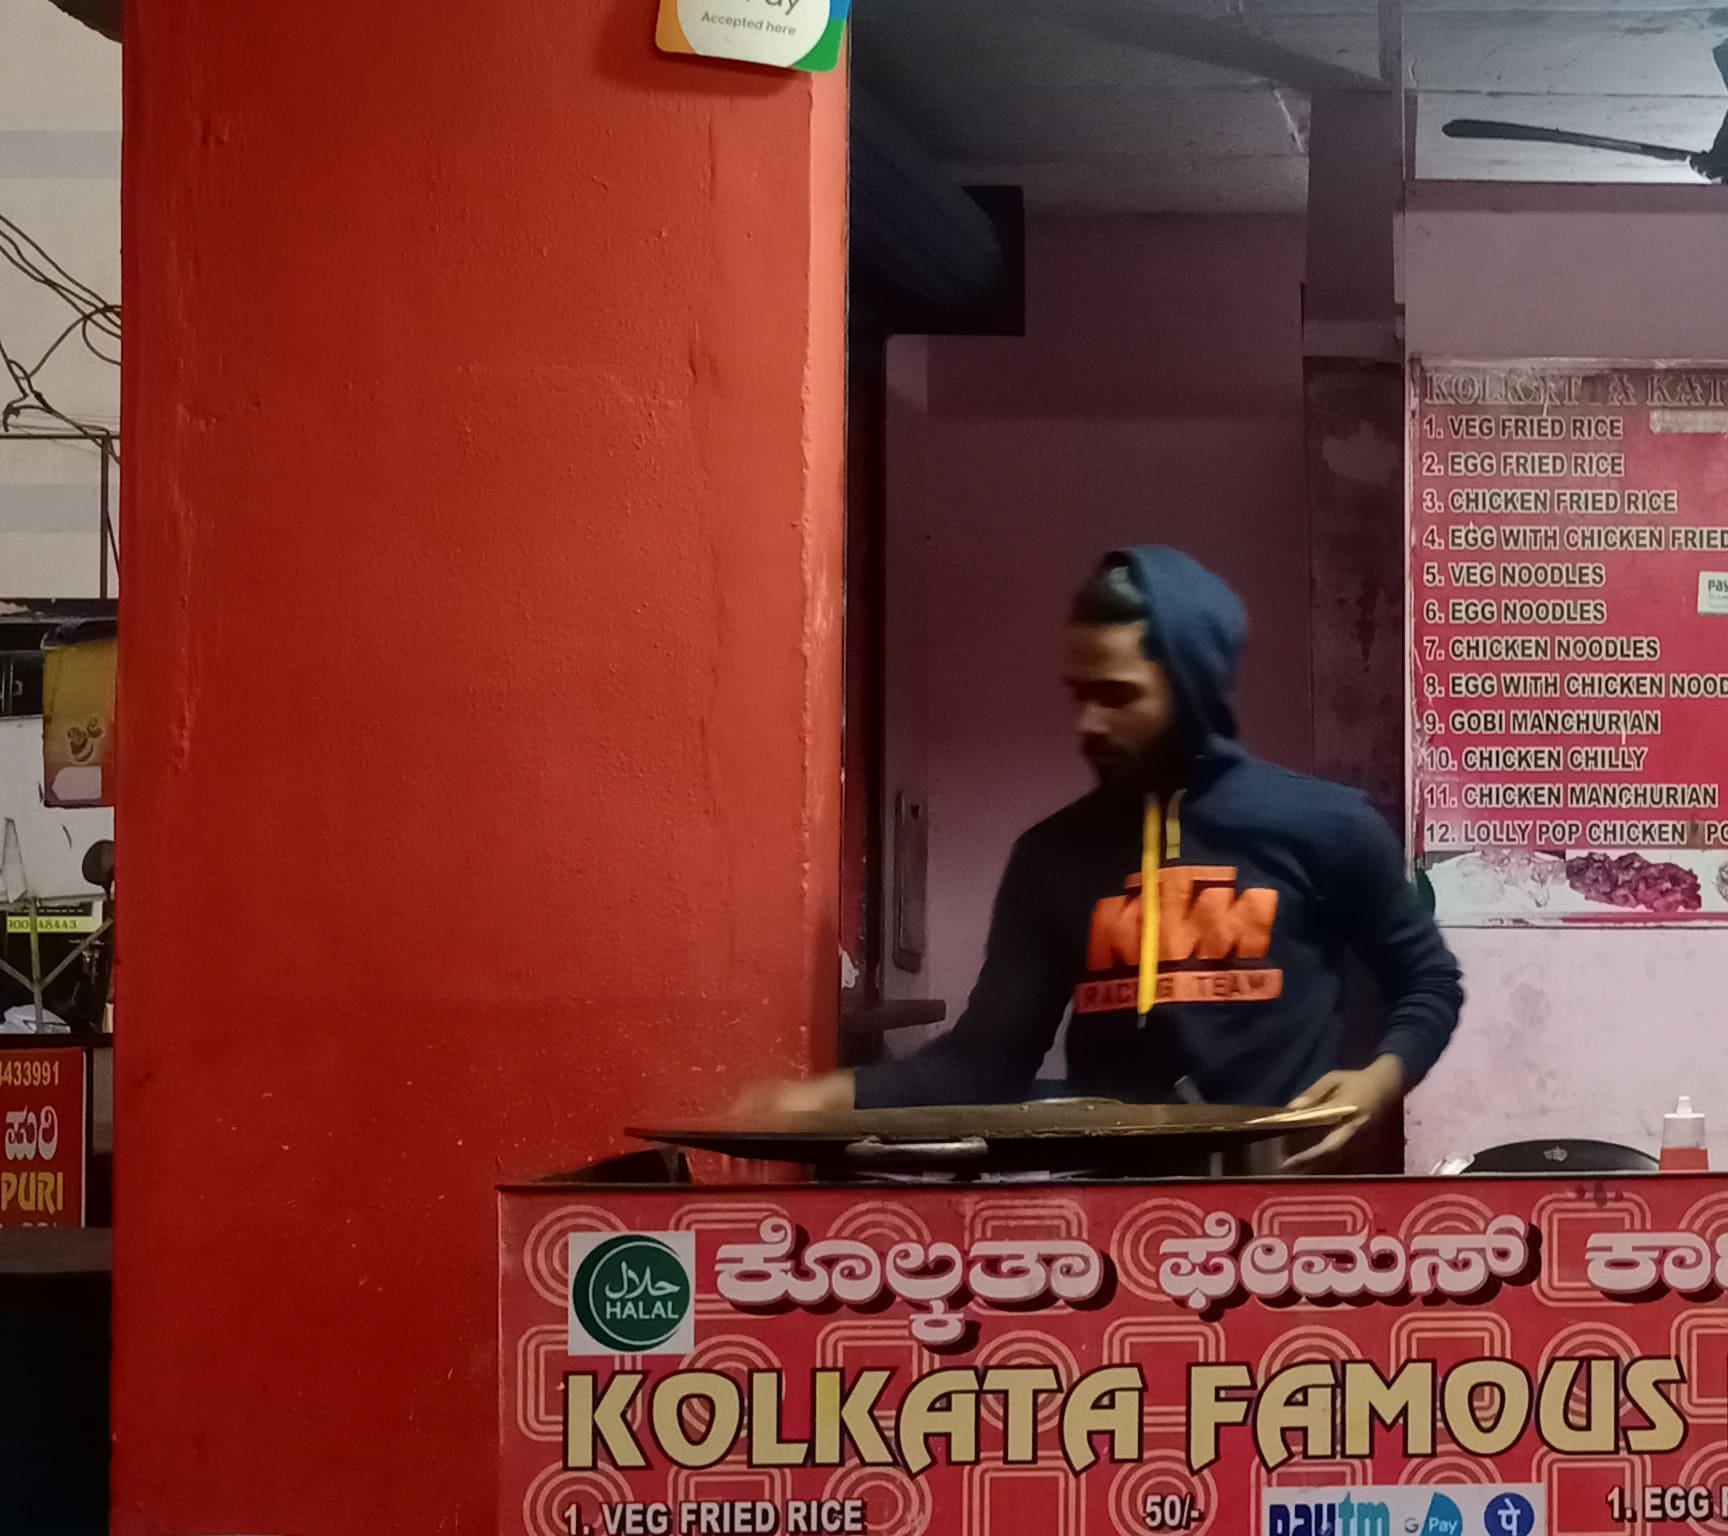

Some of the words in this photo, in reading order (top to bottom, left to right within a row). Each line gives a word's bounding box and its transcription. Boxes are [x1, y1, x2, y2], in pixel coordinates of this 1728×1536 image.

[701, 11, 763, 30] Accepted
[766, 20, 796, 36] here
[1449, 416, 1494, 438] VEG
[1501, 417, 1565, 438] FRIED
[1570, 416, 1623, 438] RICE
[1449, 490, 1548, 513] CHICKEN
[1555, 491, 1619, 513] FRIED
[1625, 490, 1678, 512] RICE
[1449, 563, 1494, 585] VEG
[1501, 564, 1605, 586] NOODLES
[1451, 674, 1495, 697] EGG
[1502, 674, 1559, 697] WITH
[1566, 674, 1665, 697] CHICKEN
[1450, 712, 1504, 733] GOBI
[1511, 712, 1661, 734] MANCHURIAN
[1463, 822, 1531, 843] LOLLY
[1537, 822, 1582, 843] POP
[1588, 822, 1687, 843] CHICKEN
[1, 1171, 63, 1214] PURI
[605, 1300, 680, 1321] HALAL
[560, 1363, 1147, 1476] KOLKATA
[1187, 1353, 1687, 1474] FAMOUS
[563, 1504, 591, 1536] 1.
[601, 1503, 670, 1536] VEG
[679, 1502, 777, 1534] FRIED
[786, 1500, 866, 1533] RICE
[1143, 1497, 1201, 1528] 50/-
[1606, 1490, 1637, 1523] 1.
[1644, 1487, 1711, 1520] EGG
[1428, 1517, 1457, 1536] Pay
